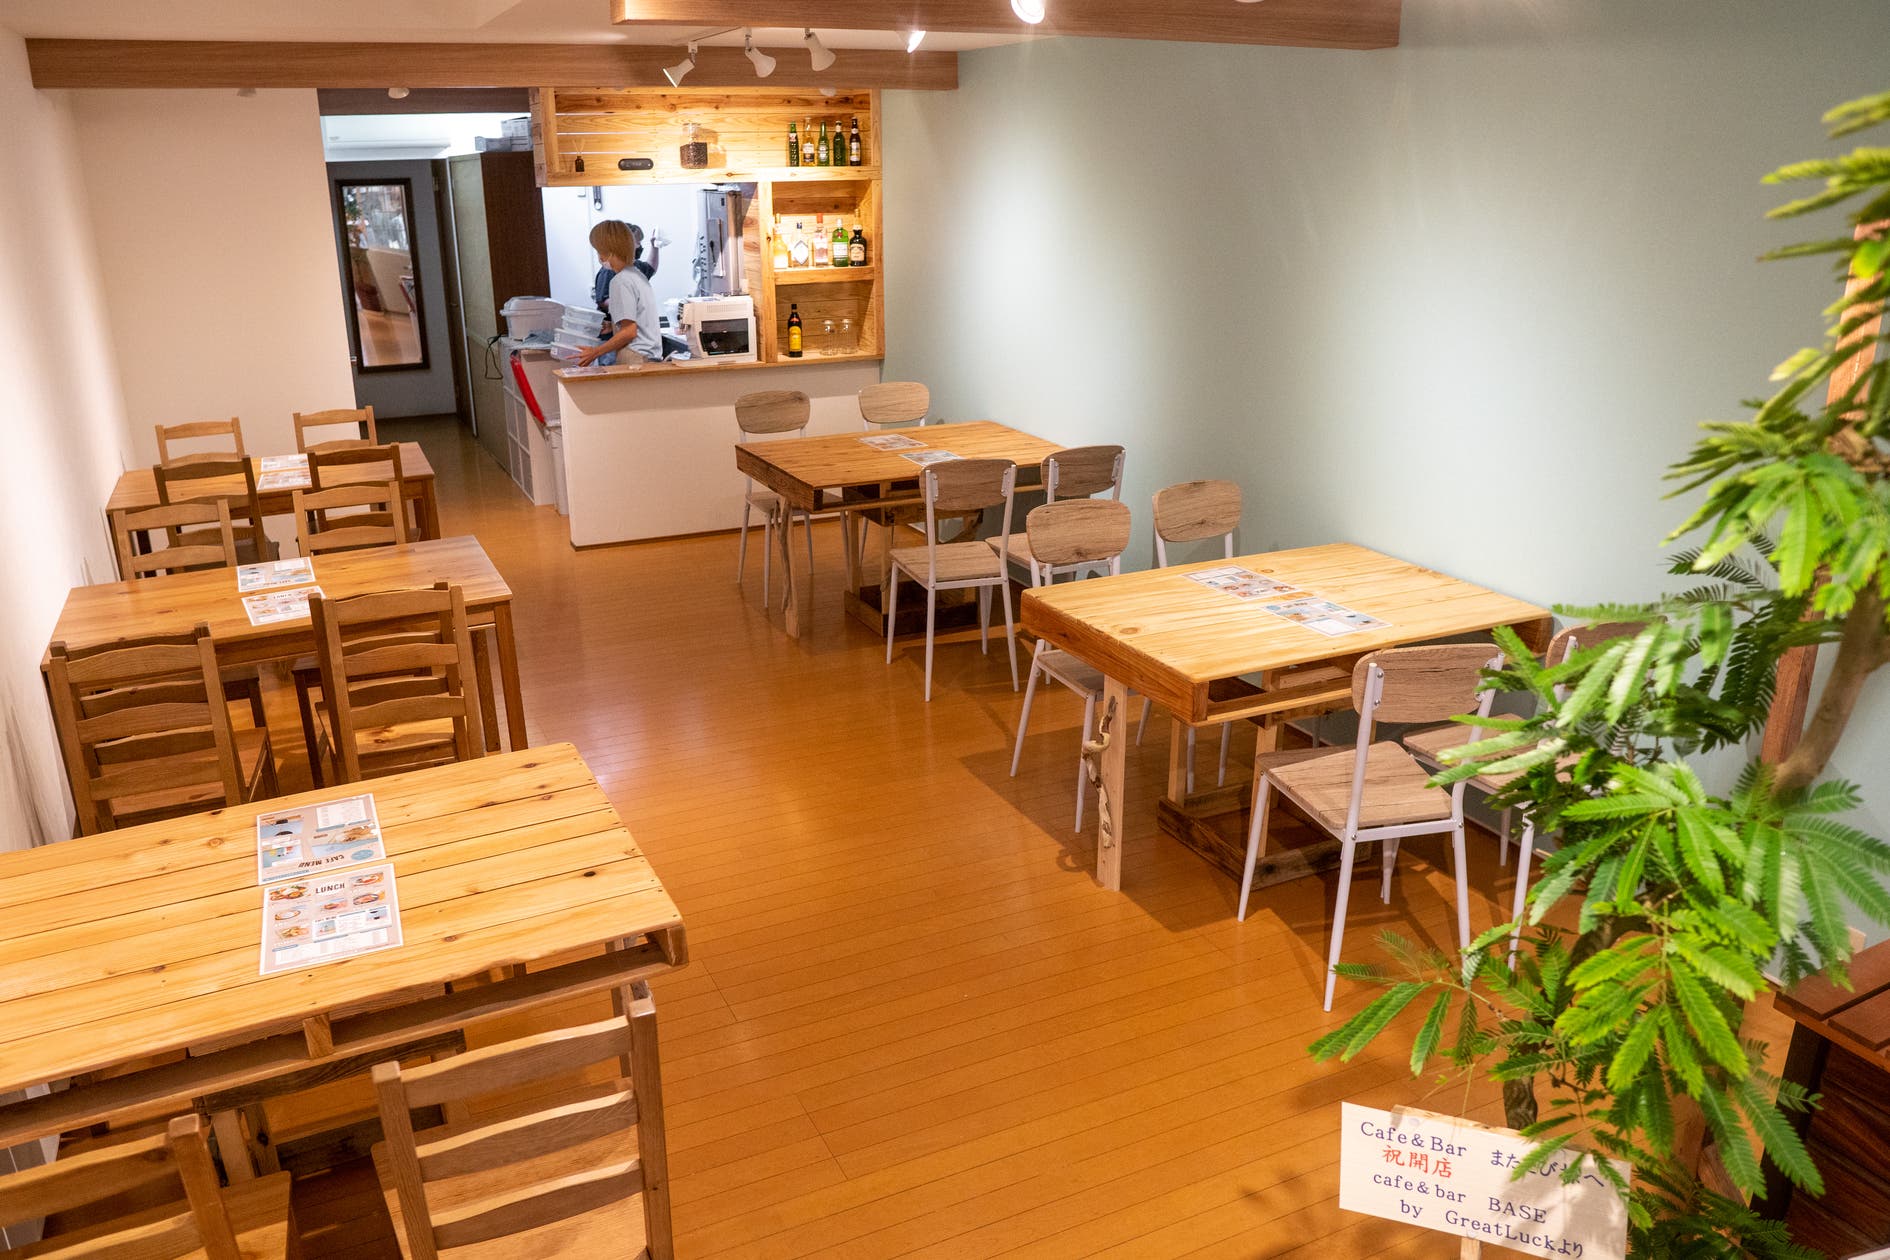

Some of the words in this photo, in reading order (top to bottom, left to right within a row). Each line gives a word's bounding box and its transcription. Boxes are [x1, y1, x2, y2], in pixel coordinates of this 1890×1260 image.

[315, 882, 345, 894] LUNCH
[1360, 1121, 1467, 1157] Cafe&Bar
[1490, 1149, 1605, 1188] またびへ
[1382, 1144, 1453, 1179] 祝開店
[1373, 1173, 1467, 1203] cafe&bar
[1488, 1196, 1548, 1224] BASE
[1400, 1199, 1423, 1219] by
